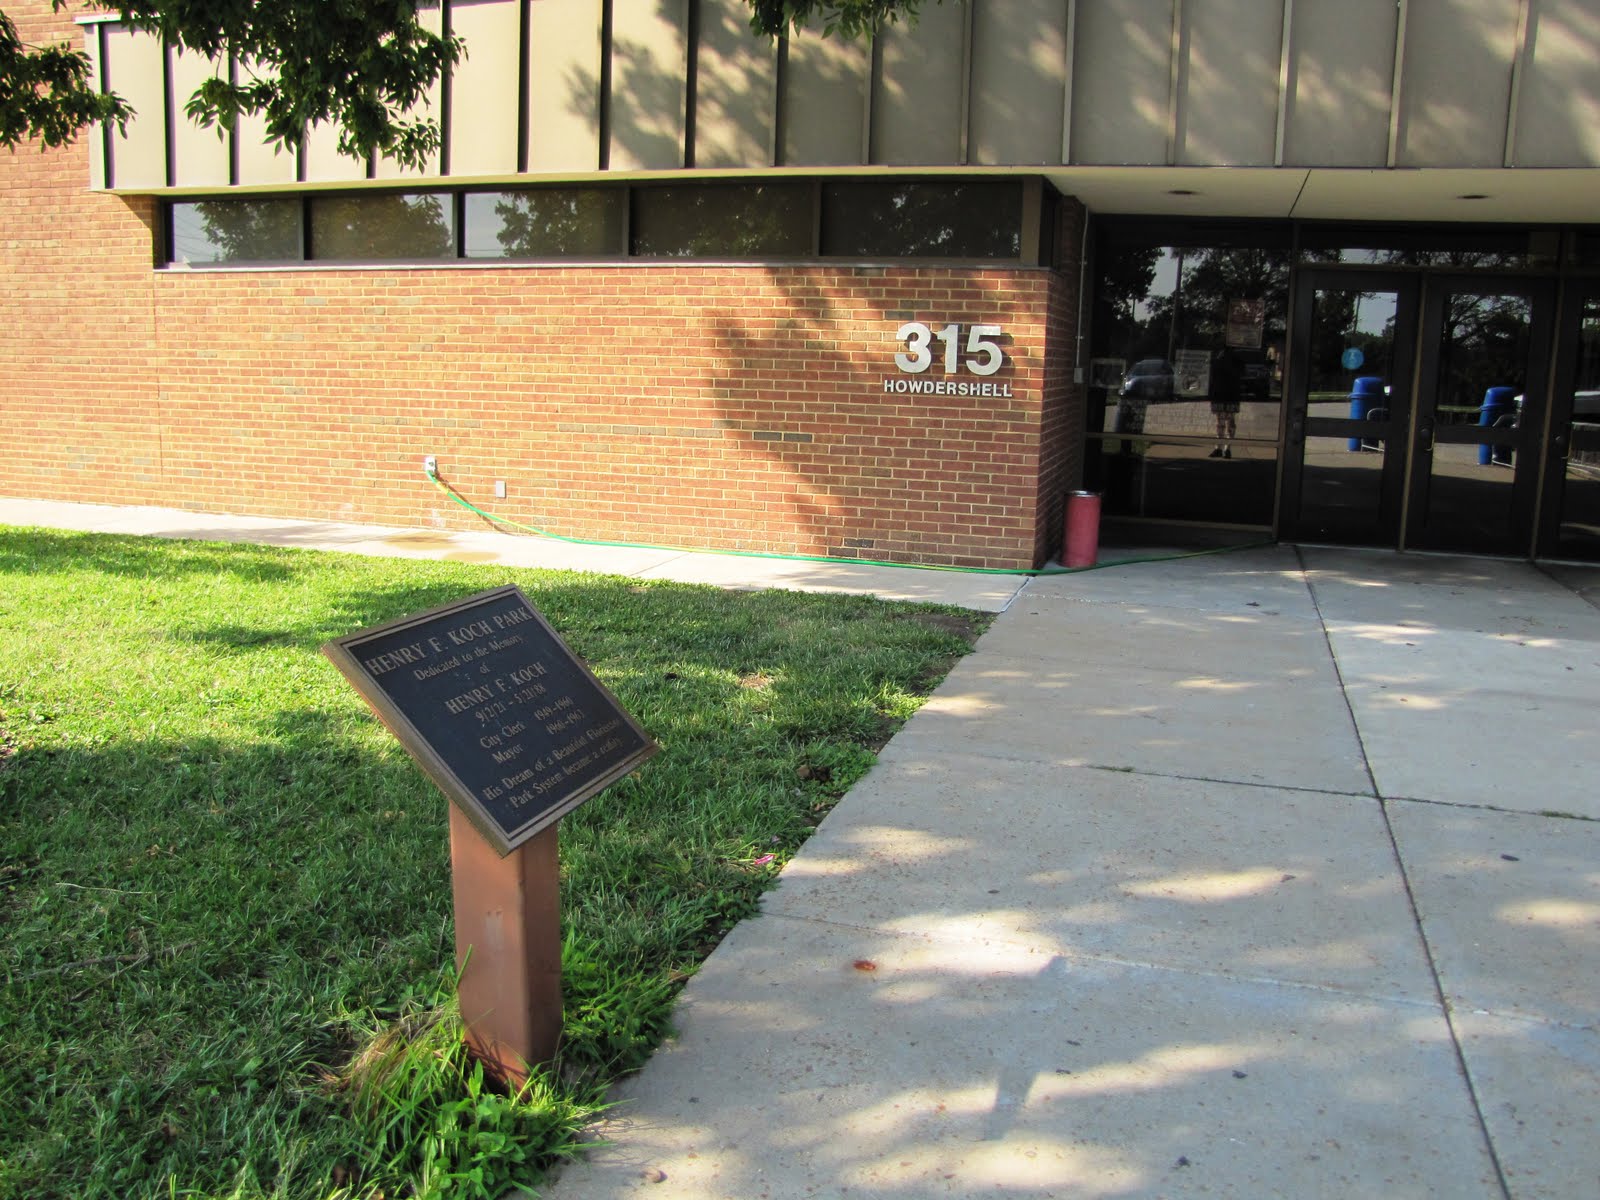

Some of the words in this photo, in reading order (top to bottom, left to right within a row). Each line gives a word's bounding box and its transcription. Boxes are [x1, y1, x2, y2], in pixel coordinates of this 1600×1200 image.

[895, 322, 1003, 376] 315
[884, 379, 1013, 397] HOWDERSHELL
[365, 644, 426, 676] HENRY
[429, 637, 448, 653] F.
[448, 621, 494, 646] KOCH
[493, 607, 532, 629] PARK
[414, 656, 460, 681] Dedicated
[461, 652, 473, 663] to
[474, 646, 490, 658] the
[489, 635, 524, 652] Memory
[479, 661, 491, 674] of
[445, 685, 494, 715] HENRY
[495, 678, 512, 692] F.
[510, 662, 547, 686] KOCH
[481, 735, 502, 749] City
[502, 721, 526, 738] Clerk
[493, 744, 523, 764] Mayor
[483, 786, 503, 801] His
[502, 769, 534, 790] Dream
[535, 757, 546, 772] of
[510, 790, 534, 809] Park
[533, 773, 563, 795] System
